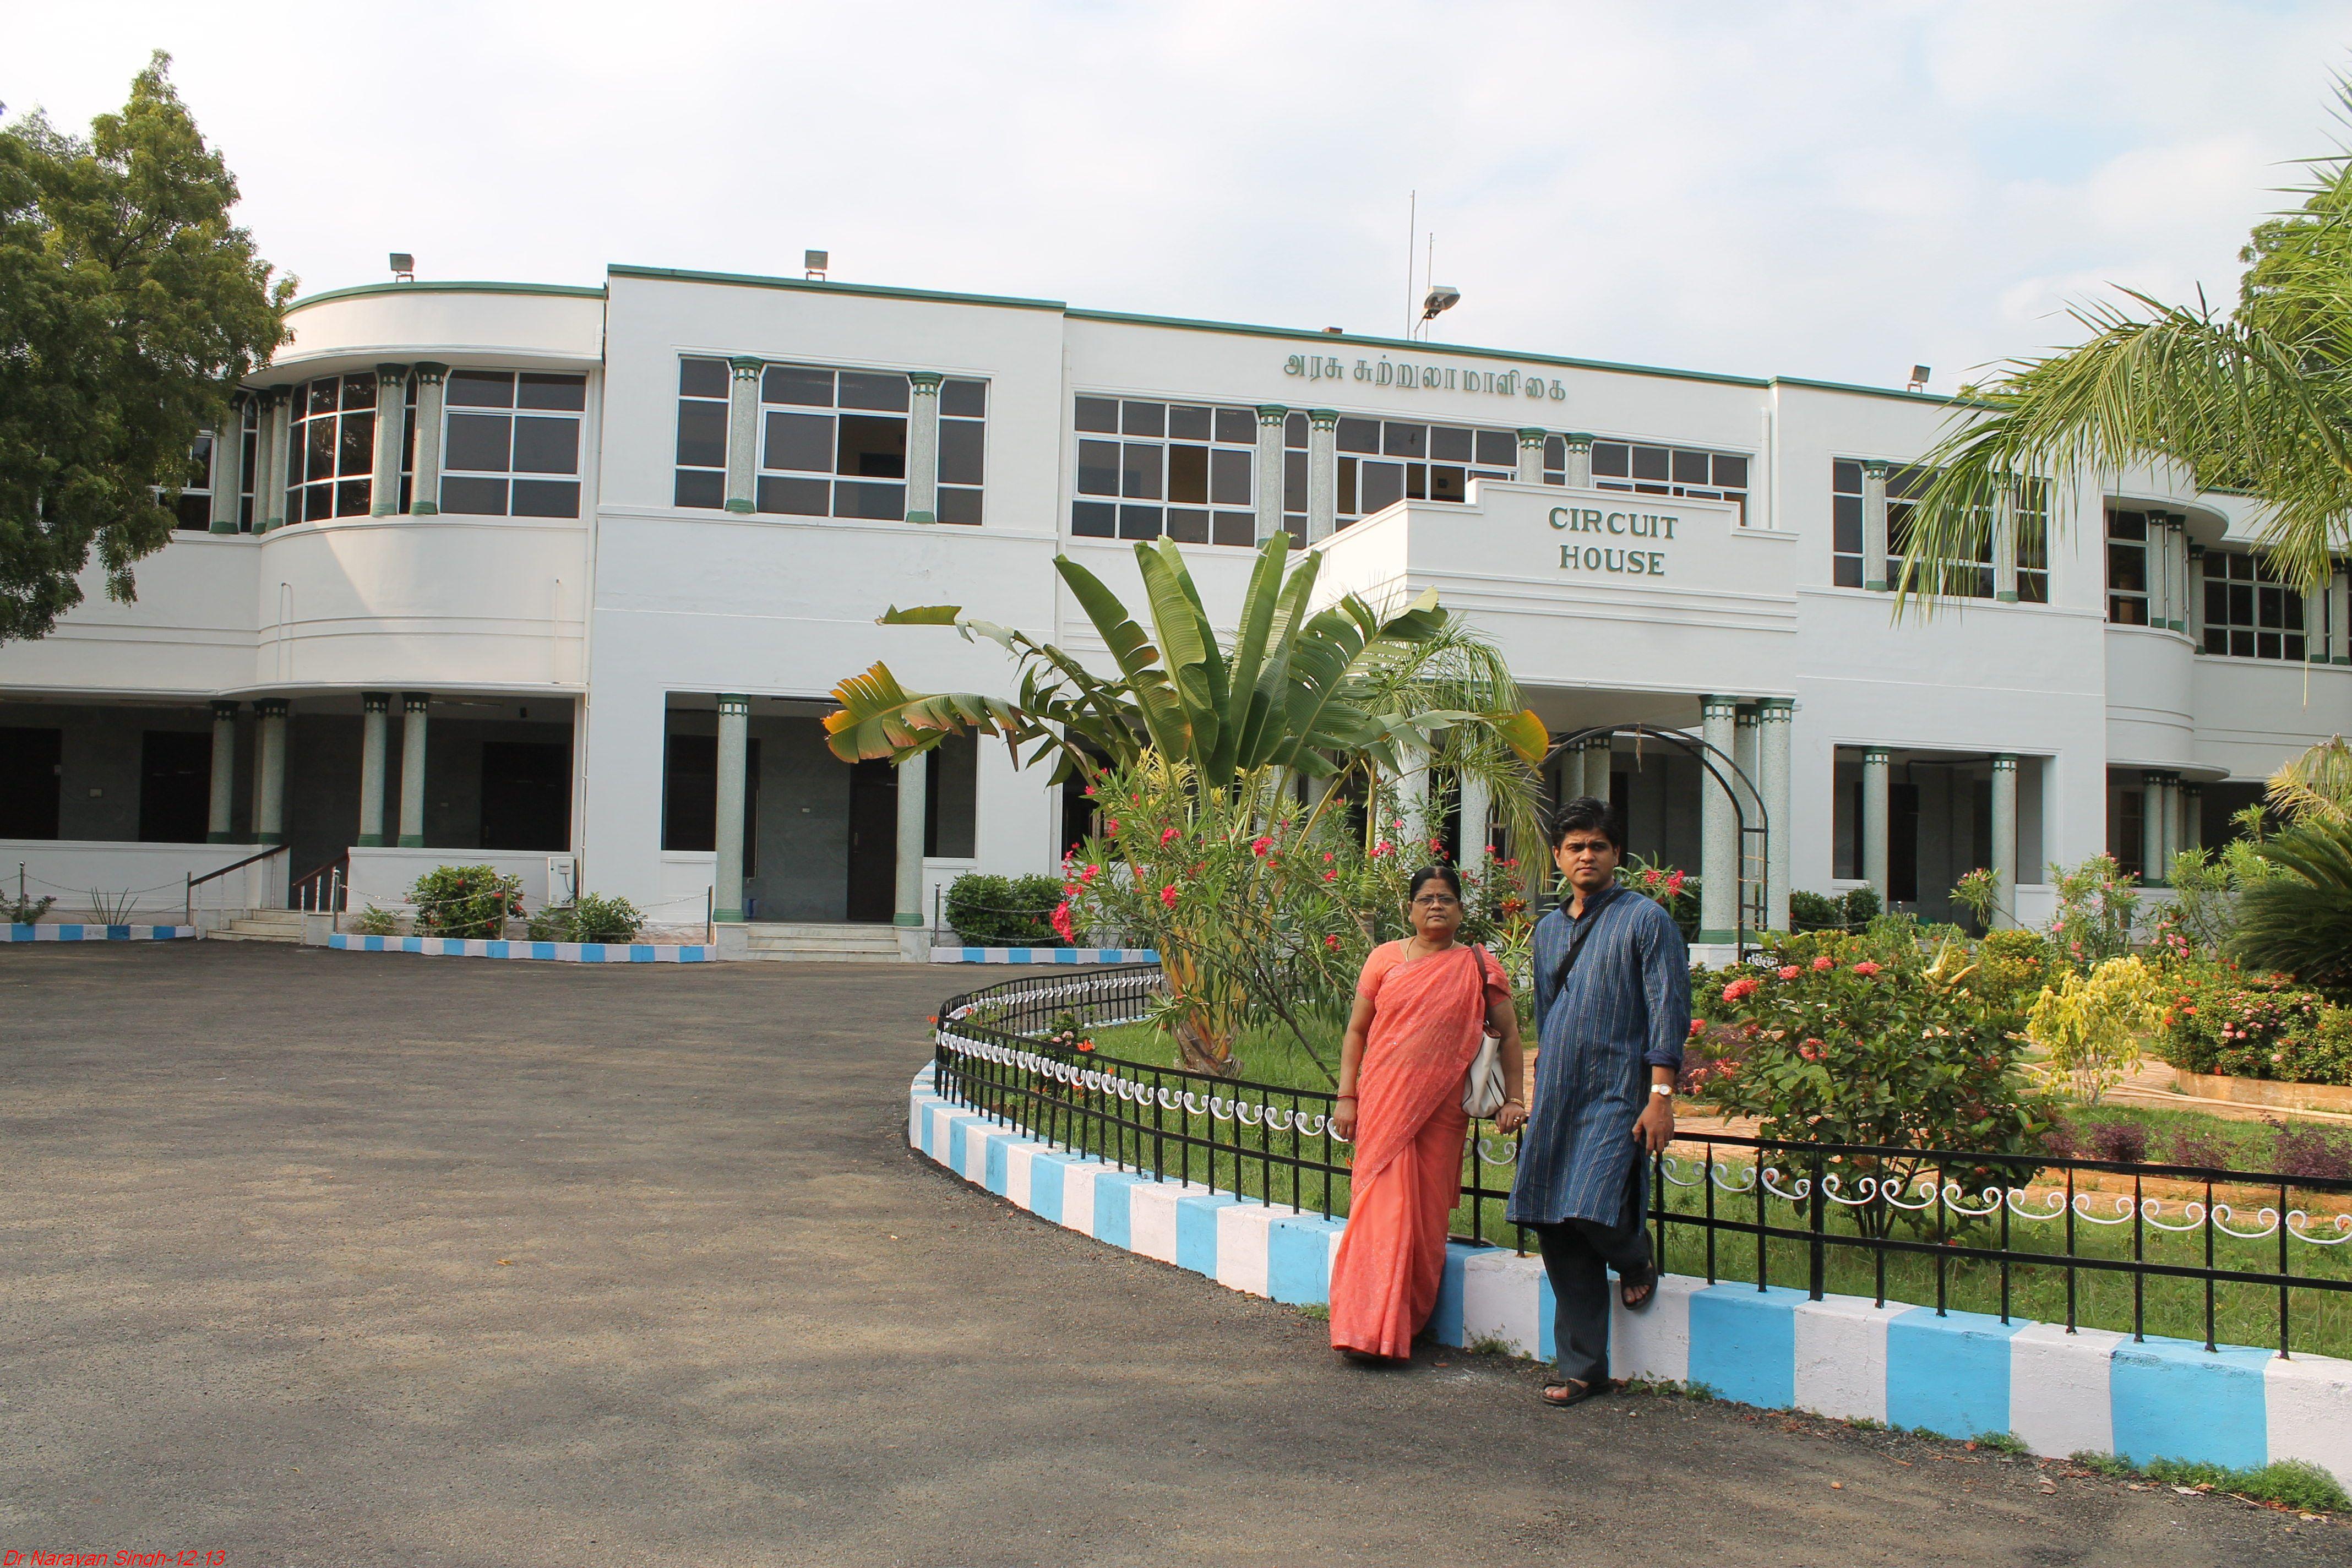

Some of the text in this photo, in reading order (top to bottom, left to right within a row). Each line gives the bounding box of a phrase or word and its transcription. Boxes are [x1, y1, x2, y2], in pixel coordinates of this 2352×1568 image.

[1283, 354, 1344, 382] அரசு
[1548, 507, 1679, 540] CIRCUIT
[1559, 544, 1665, 576] HOUSE
